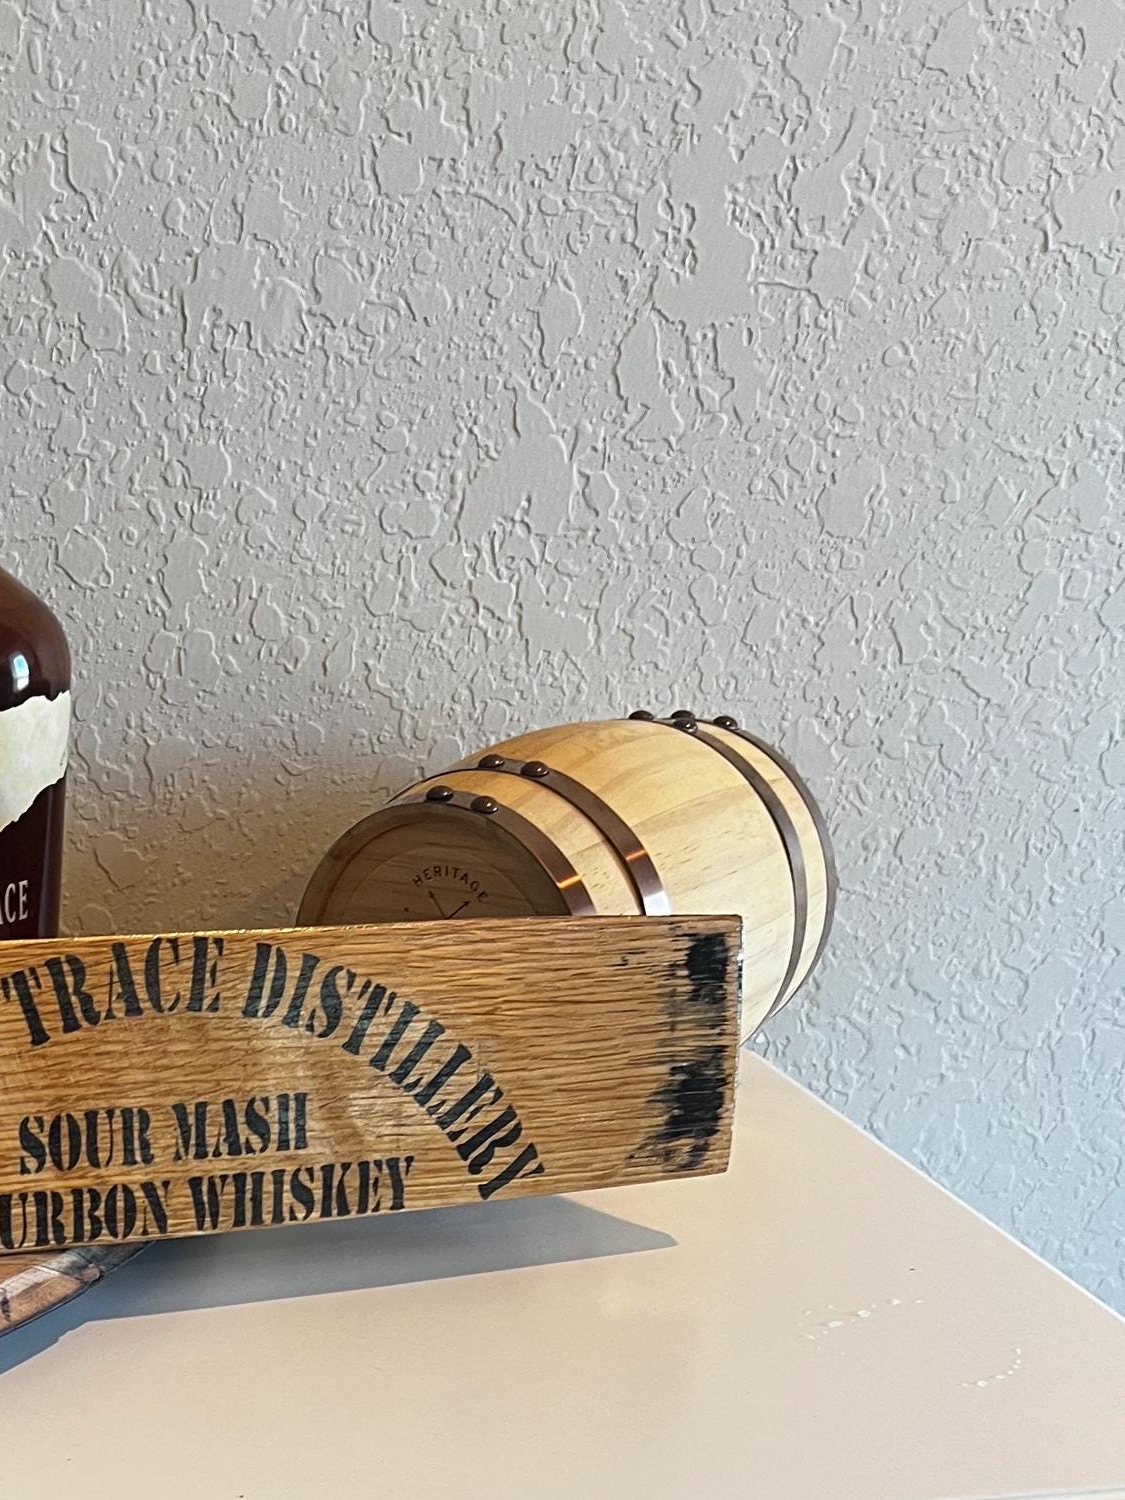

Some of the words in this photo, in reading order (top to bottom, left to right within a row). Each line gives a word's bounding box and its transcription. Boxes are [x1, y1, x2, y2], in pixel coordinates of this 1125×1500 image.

[413, 865, 489, 903] HERITAGE
[0, 937, 224, 1046] TRACE
[241, 942, 545, 1200] DISTILLERY
[18, 1107, 154, 1175] SOUR
[172, 1092, 309, 1160] MASH
[187, 1155, 414, 1232] WHISKEY
